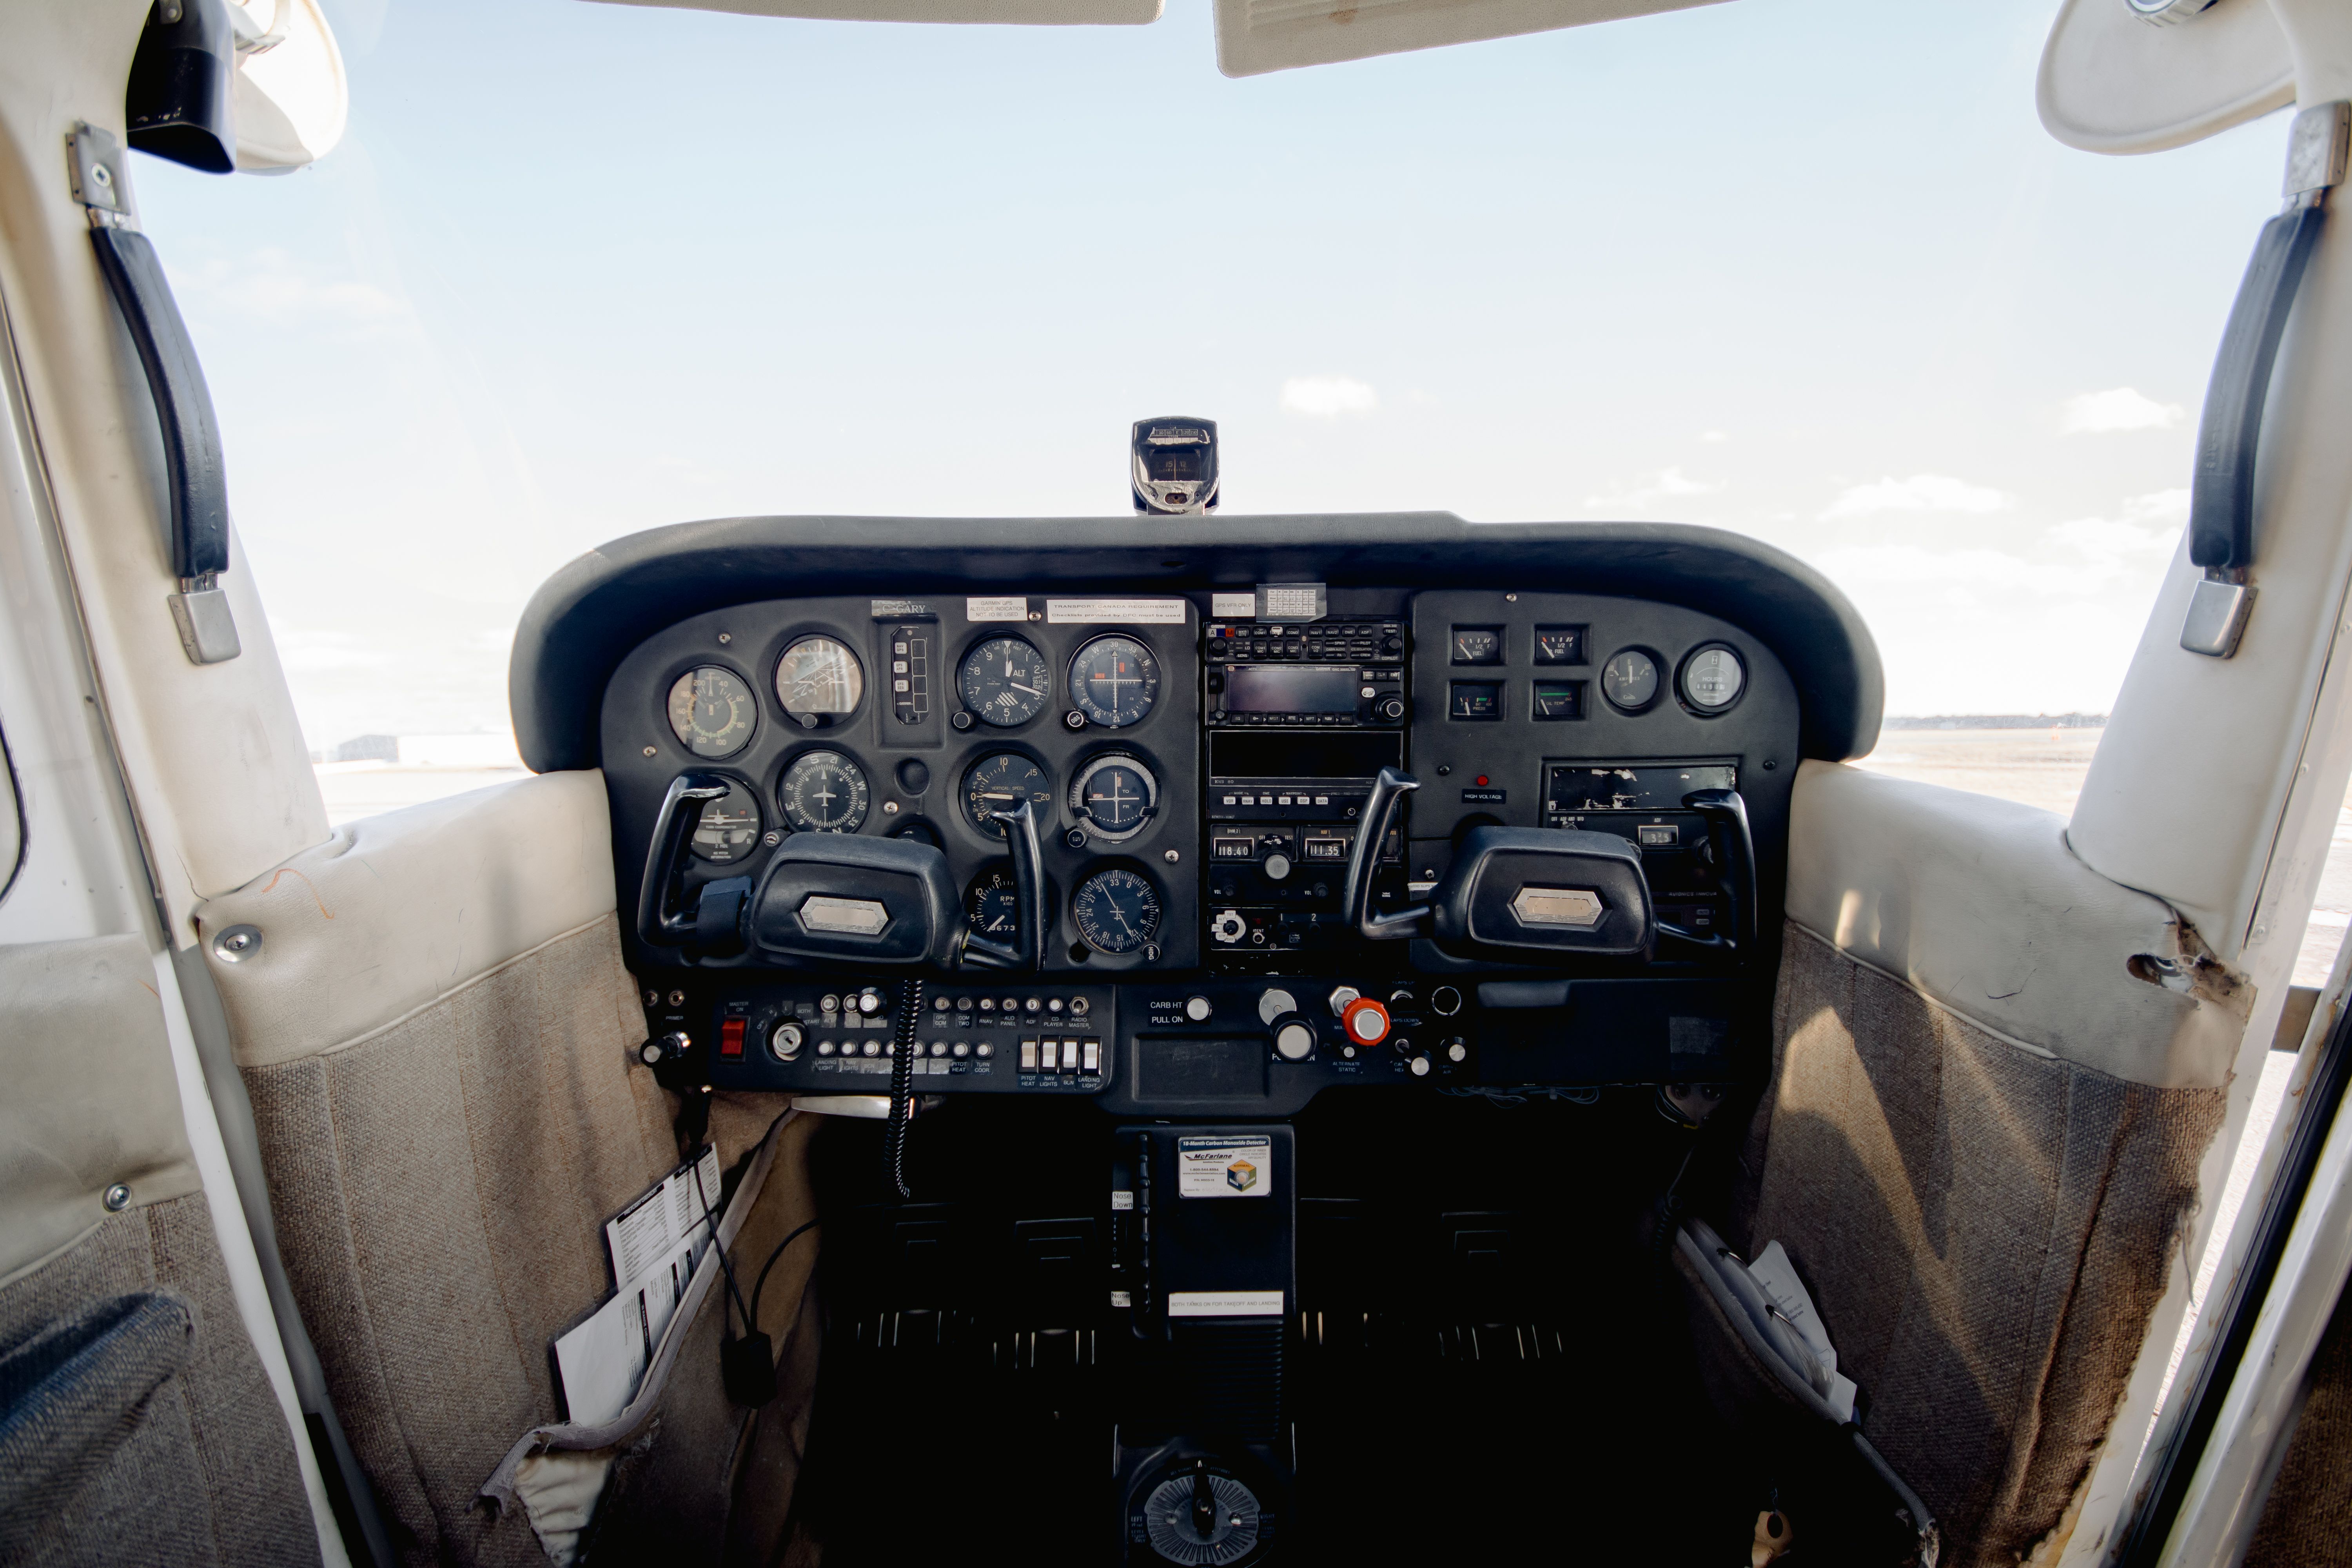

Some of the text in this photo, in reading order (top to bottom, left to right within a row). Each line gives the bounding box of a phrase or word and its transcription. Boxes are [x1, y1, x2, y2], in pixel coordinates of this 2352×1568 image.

[986, 652, 993, 661] 9
[974, 667, 980, 675] 8
[1034, 665, 1040, 674] 2
[974, 687, 980, 695] 7
[986, 702, 993, 710] 6
[1021, 702, 1028, 711] 4
[1004, 708, 1010, 717] 5
[1000, 757, 1008, 766] 10
[845, 764, 857, 775] 24
[786, 783, 794, 791] 12
[971, 792, 976, 801] 0
[978, 813, 983, 821] 5
[1219, 846, 1248, 856] 118.40
[1310, 845, 1339, 855] 111.35
